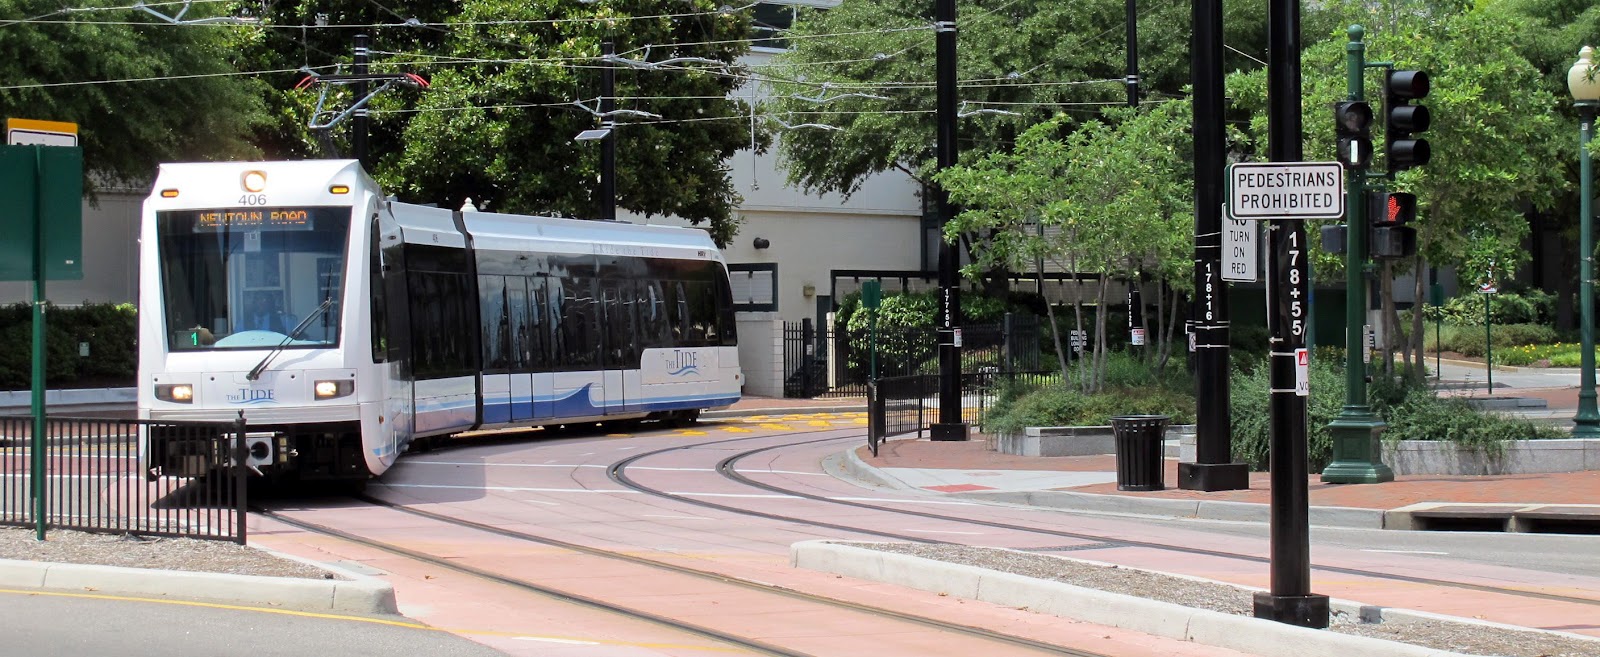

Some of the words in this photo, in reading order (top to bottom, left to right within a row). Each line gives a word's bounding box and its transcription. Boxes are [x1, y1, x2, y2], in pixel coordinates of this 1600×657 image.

[1238, 172, 1335, 188] PEDESTRIANS
[238, 194, 267, 206] 406
[1241, 193, 1333, 209] PROHIBITED
[270, 210, 307, 224] ROAD
[1230, 230, 1250, 242] TURN
[1233, 246, 1245, 258] ON
[1231, 262, 1247, 274] RED
[1288, 231, 1302, 336] 178+55
[1205, 263, 1213, 321] 178+16
[191, 332, 198, 346] 1
[665, 360, 675, 369] THE
[674, 350, 697, 368] TIDE
[239, 389, 275, 400] TIDE
